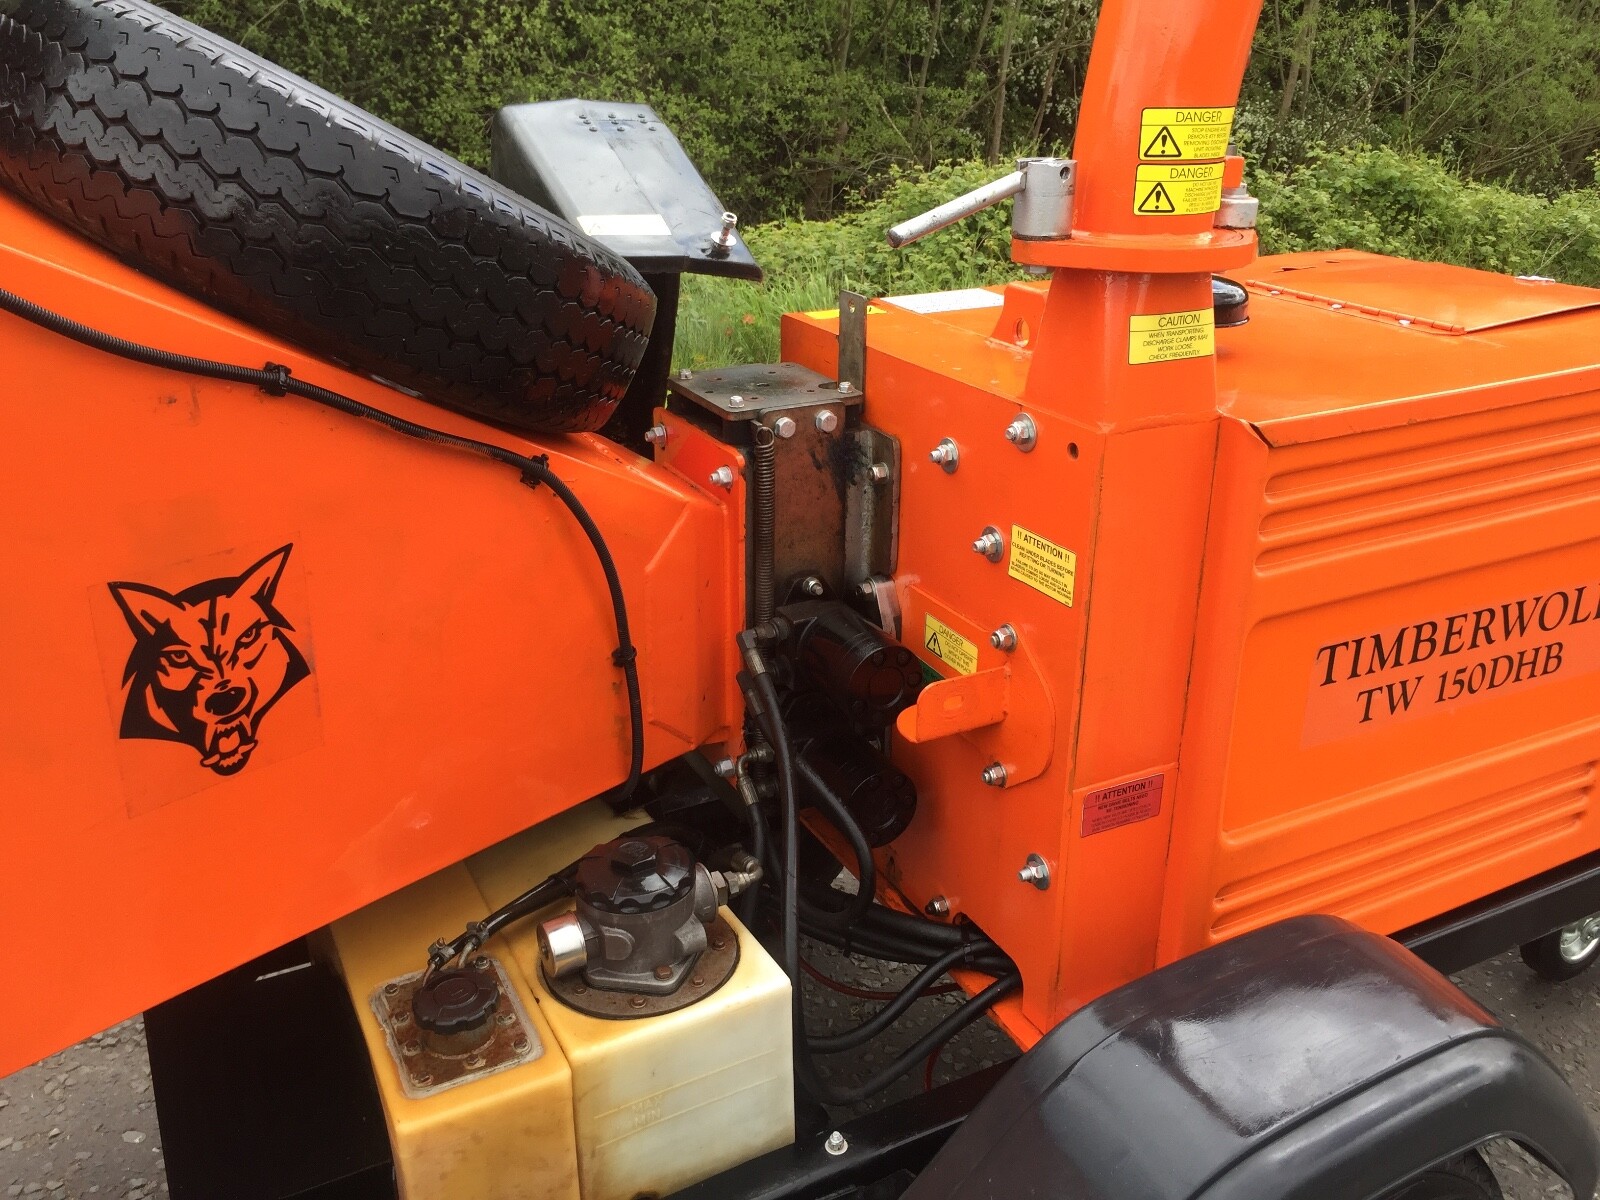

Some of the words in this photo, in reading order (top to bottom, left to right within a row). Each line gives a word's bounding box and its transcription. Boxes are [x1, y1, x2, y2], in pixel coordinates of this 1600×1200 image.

[1176, 111, 1222, 122] DANGER
[1170, 167, 1213, 178] DANGER
[1158, 314, 1200, 327] CAUTION
[1166, 327, 1204, 336] TRANSPORTING
[1143, 338, 1174, 346] DISCHARGE
[1176, 335, 1197, 343] CLAMPS
[1169, 350, 1200, 358] FREQUENTLY
[1023, 534, 1063, 560] ATTENTION
[939, 625, 963, 646] DANGER
[1357, 675, 1424, 723] TW
[1435, 641, 1564, 703] 150DHB
[1102, 782, 1146, 801] ATTENTION
